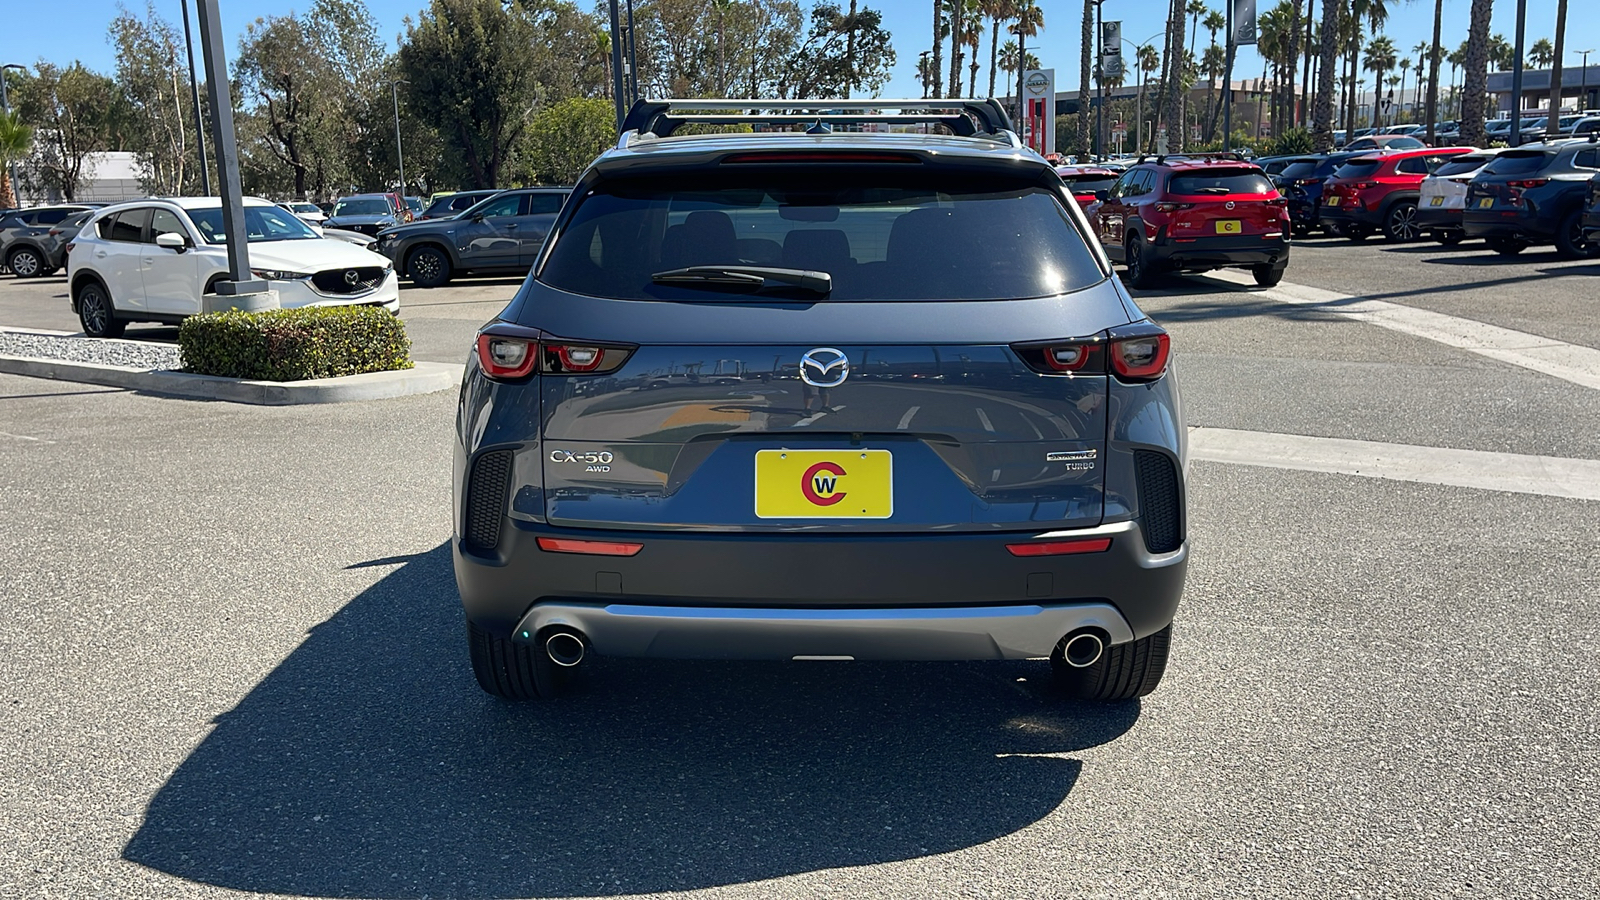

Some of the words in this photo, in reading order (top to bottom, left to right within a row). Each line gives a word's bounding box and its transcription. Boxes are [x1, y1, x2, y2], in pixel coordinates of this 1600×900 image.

[550, 450, 614, 464] CX-50
[585, 465, 611, 473] AWD
[1066, 462, 1095, 471] TURBO
